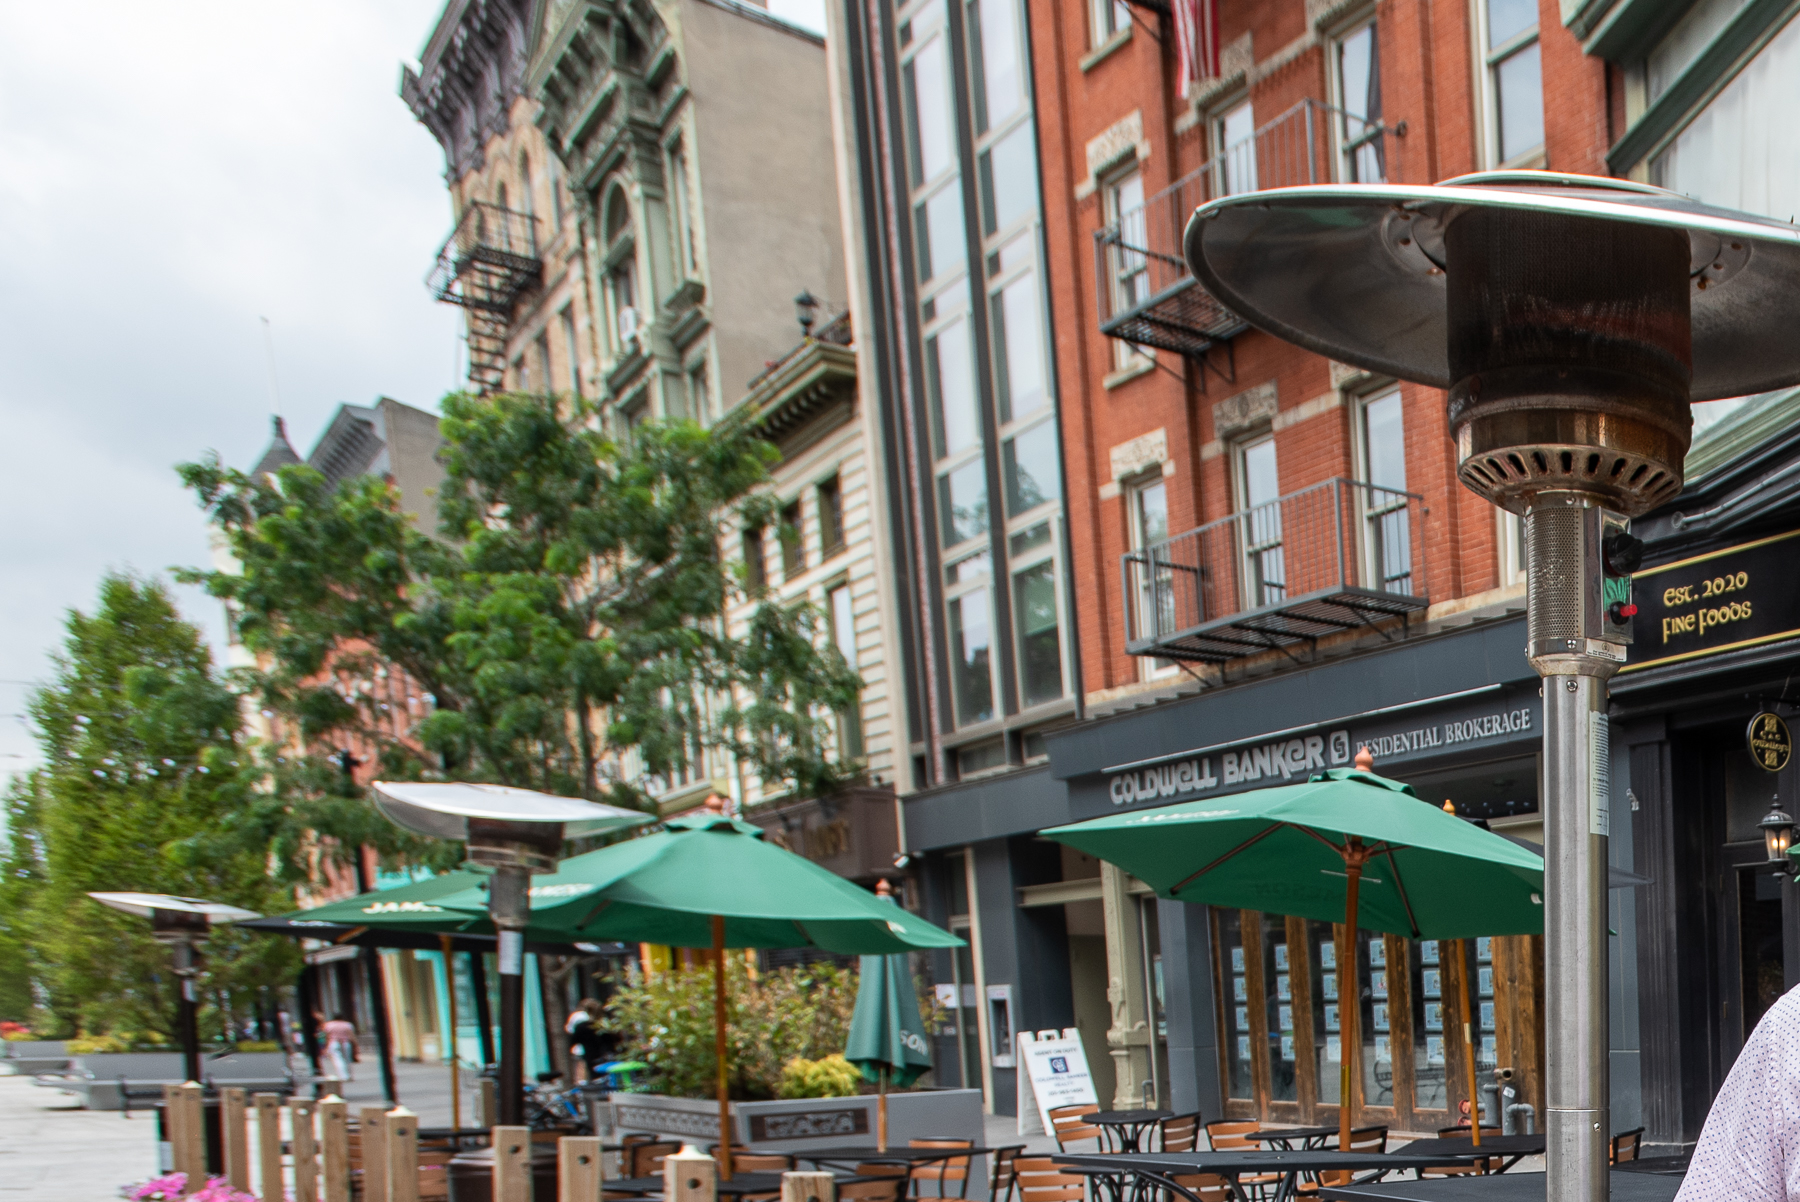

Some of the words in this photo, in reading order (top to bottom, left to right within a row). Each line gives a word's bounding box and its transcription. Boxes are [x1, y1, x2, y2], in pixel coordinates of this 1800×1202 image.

[1701, 570, 1749, 599] 2020
[1109, 761, 1219, 806] COLDWELL
[1222, 733, 1325, 786] BANKER
[1356, 725, 1442, 759] RESIDENTIAL
[1444, 707, 1532, 744] BROKERAGE
